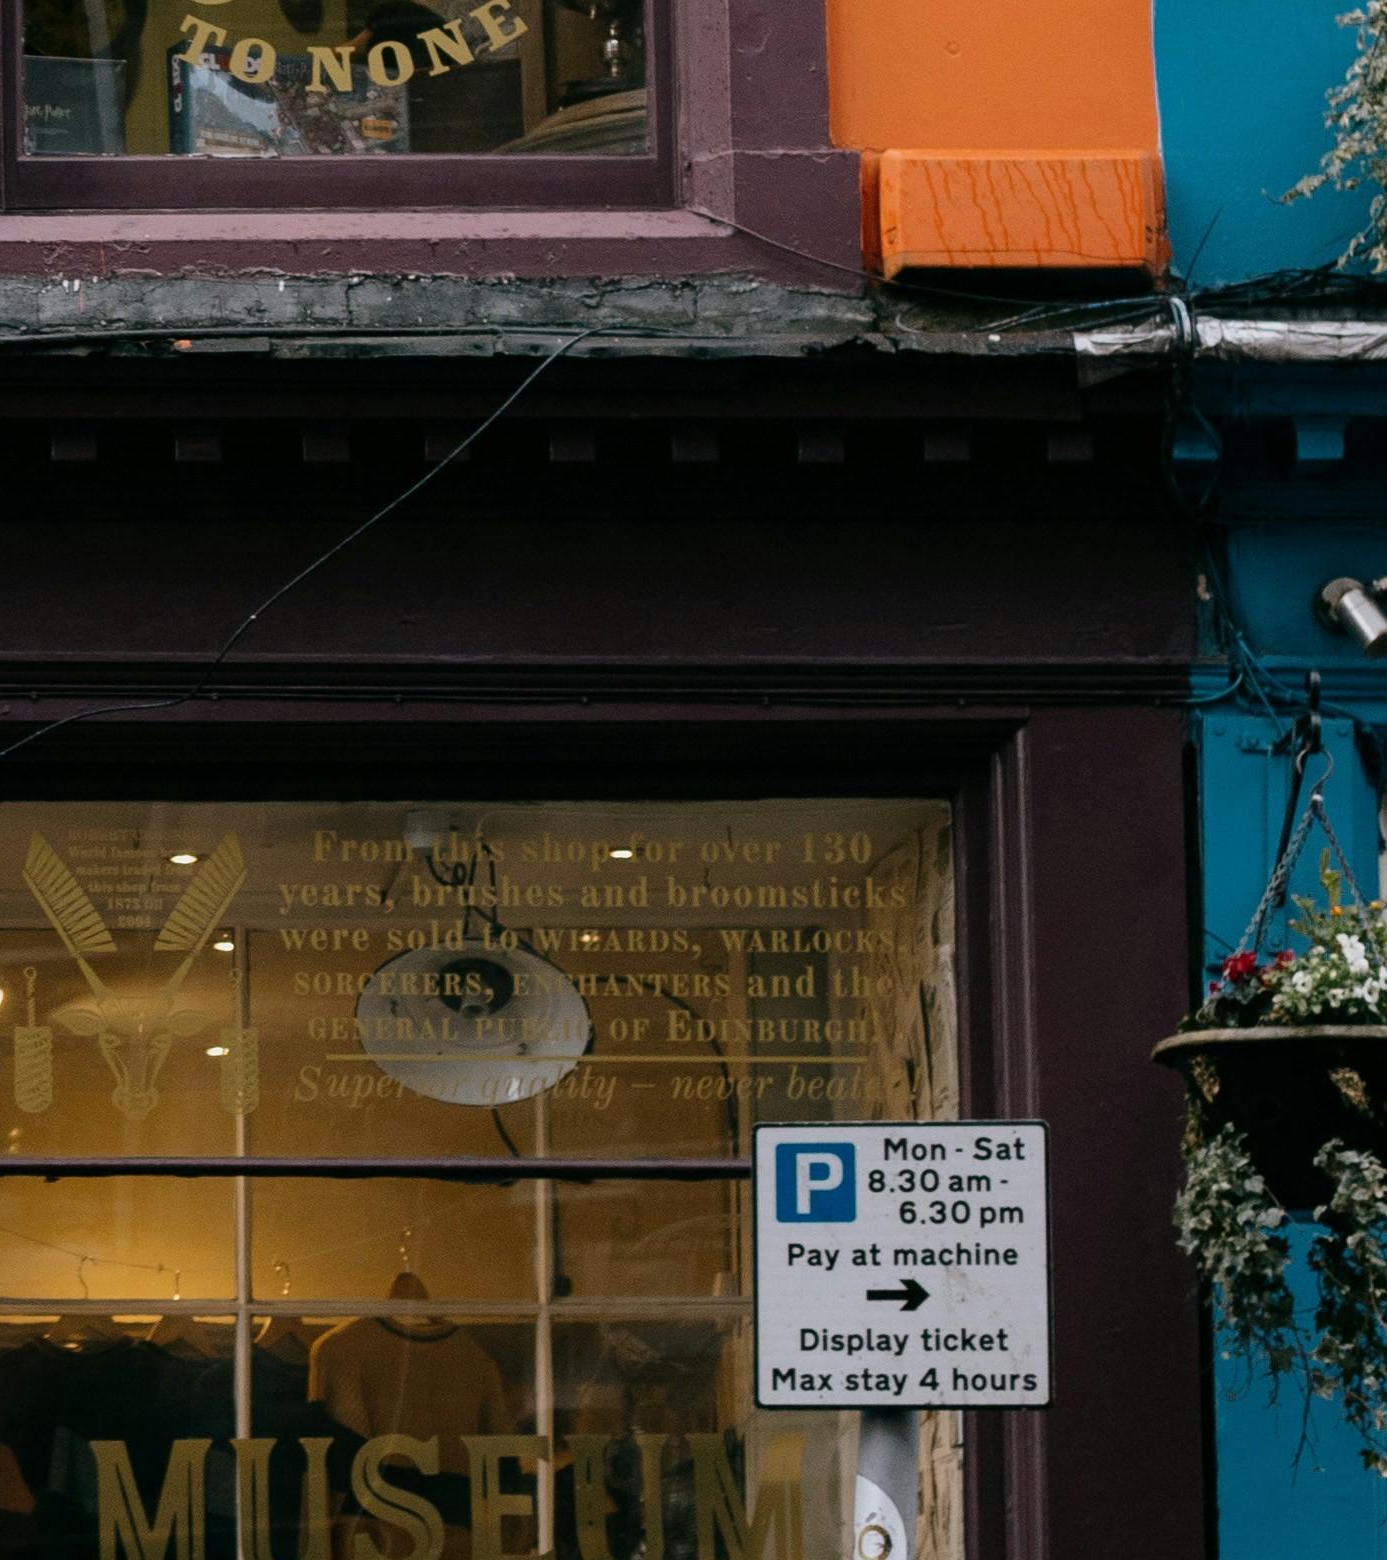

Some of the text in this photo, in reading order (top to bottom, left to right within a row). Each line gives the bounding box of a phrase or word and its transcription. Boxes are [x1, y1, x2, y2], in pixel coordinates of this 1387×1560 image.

[175, 14, 278, 83] TO
[313, 830, 872, 873] From this shop for over 130
[412, 876, 907, 910] brushes and broomsticks
[280, 919, 520, 953] were sold to
[747, 966, 894, 998] and the
[307, 1017, 459, 1041] GENERAL
[672, 1073, 772, 1100] never
[883, 1137, 1026, 1161] Mon Sat
[868, 1169, 991, 1193] 8.30 am
[899, 1200, 1024, 1228] 6.30 pm
[787, 1243, 1019, 1271] Pay at machine
[800, 1328, 1009, 1356] Display ticket
[772, 1367, 1038, 1396] Max stay 4 hours
